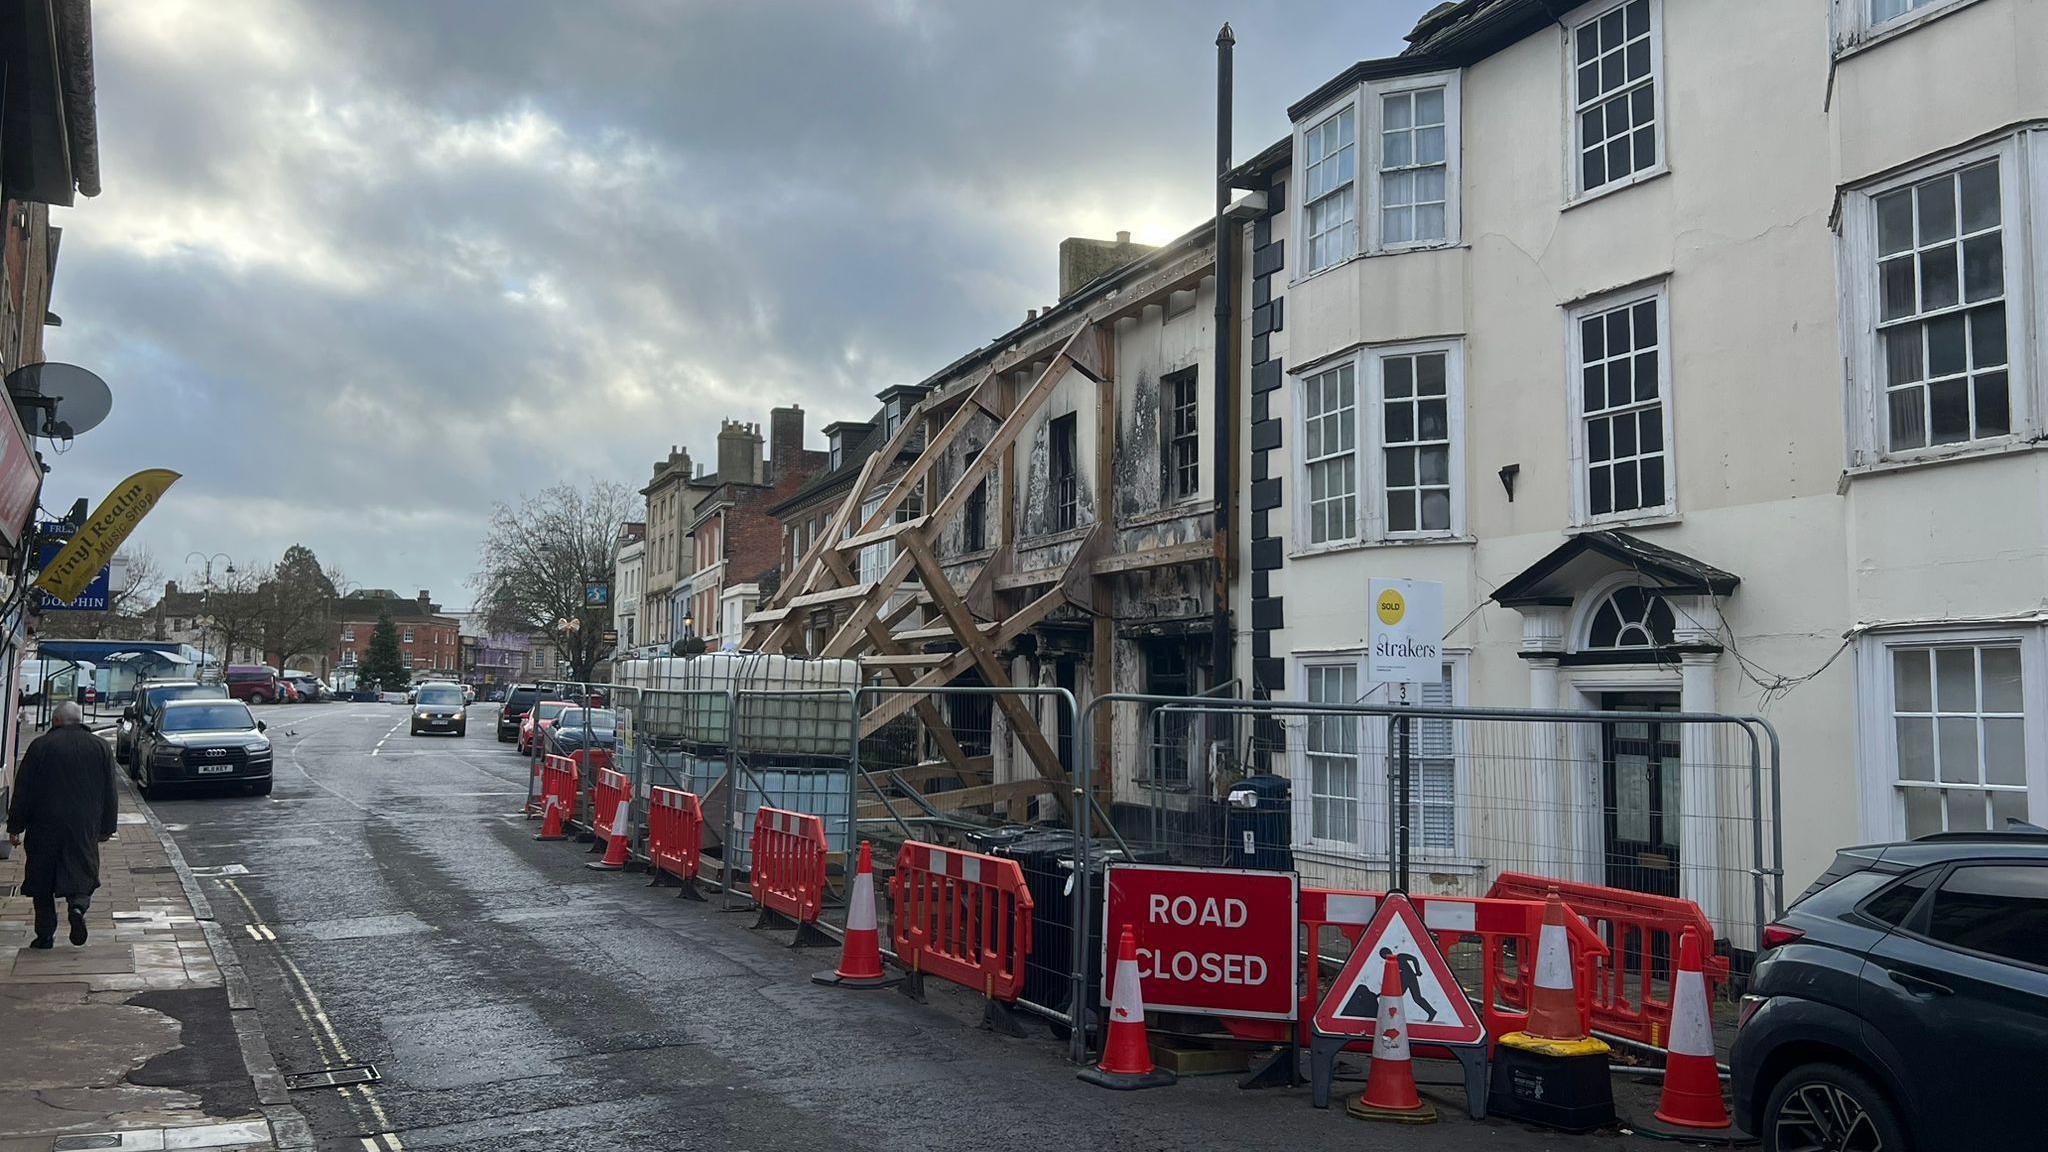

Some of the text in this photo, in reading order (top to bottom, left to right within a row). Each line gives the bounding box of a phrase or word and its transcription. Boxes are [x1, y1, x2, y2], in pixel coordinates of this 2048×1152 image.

[125, 493, 154, 522] Shop
[49, 484, 144, 586] Vinyl Realm
[1381, 602, 1400, 611] SOLD
[1376, 636, 1436, 658] strakers
[1149, 893, 1248, 928] ROAD
[1135, 947, 1268, 985] CLOSED
